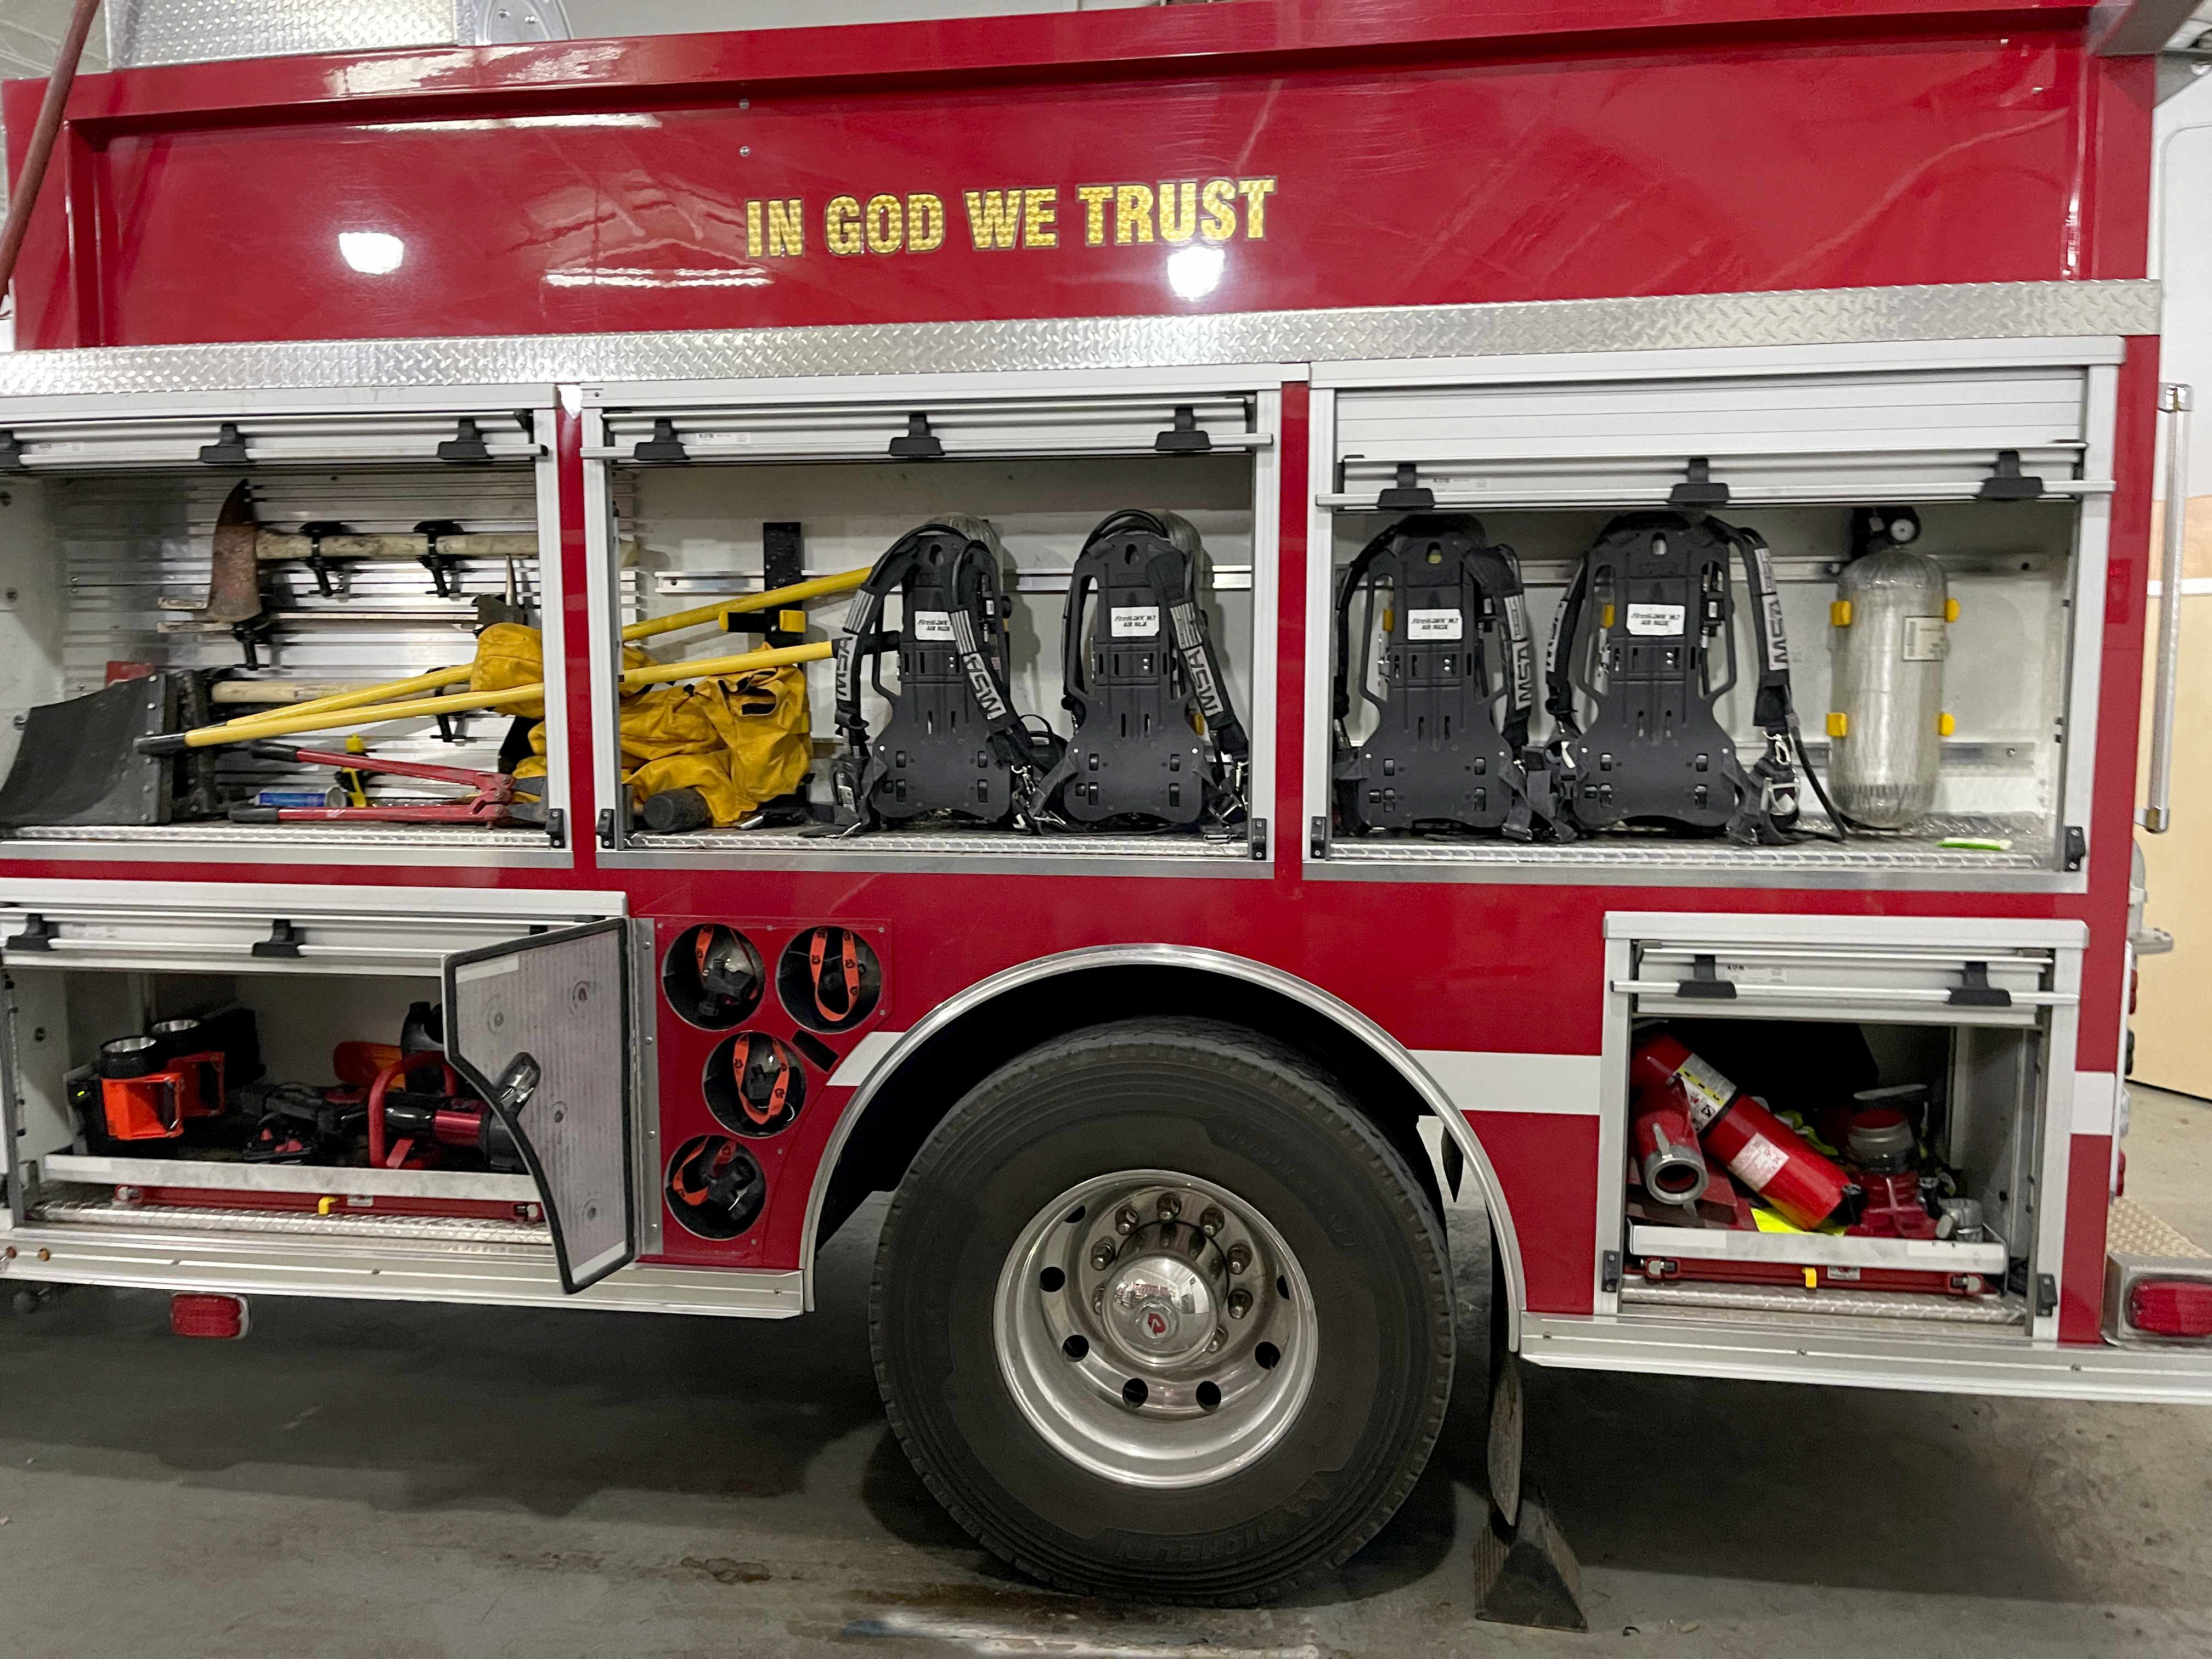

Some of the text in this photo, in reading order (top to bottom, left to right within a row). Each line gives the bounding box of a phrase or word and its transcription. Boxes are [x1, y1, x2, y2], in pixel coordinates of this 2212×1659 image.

[745, 175, 1278, 258] IN GOD WE TRUST
[836, 635, 853, 697] MSA
[963, 656, 1002, 715] MSA
[1188, 648, 1218, 711] MSA
